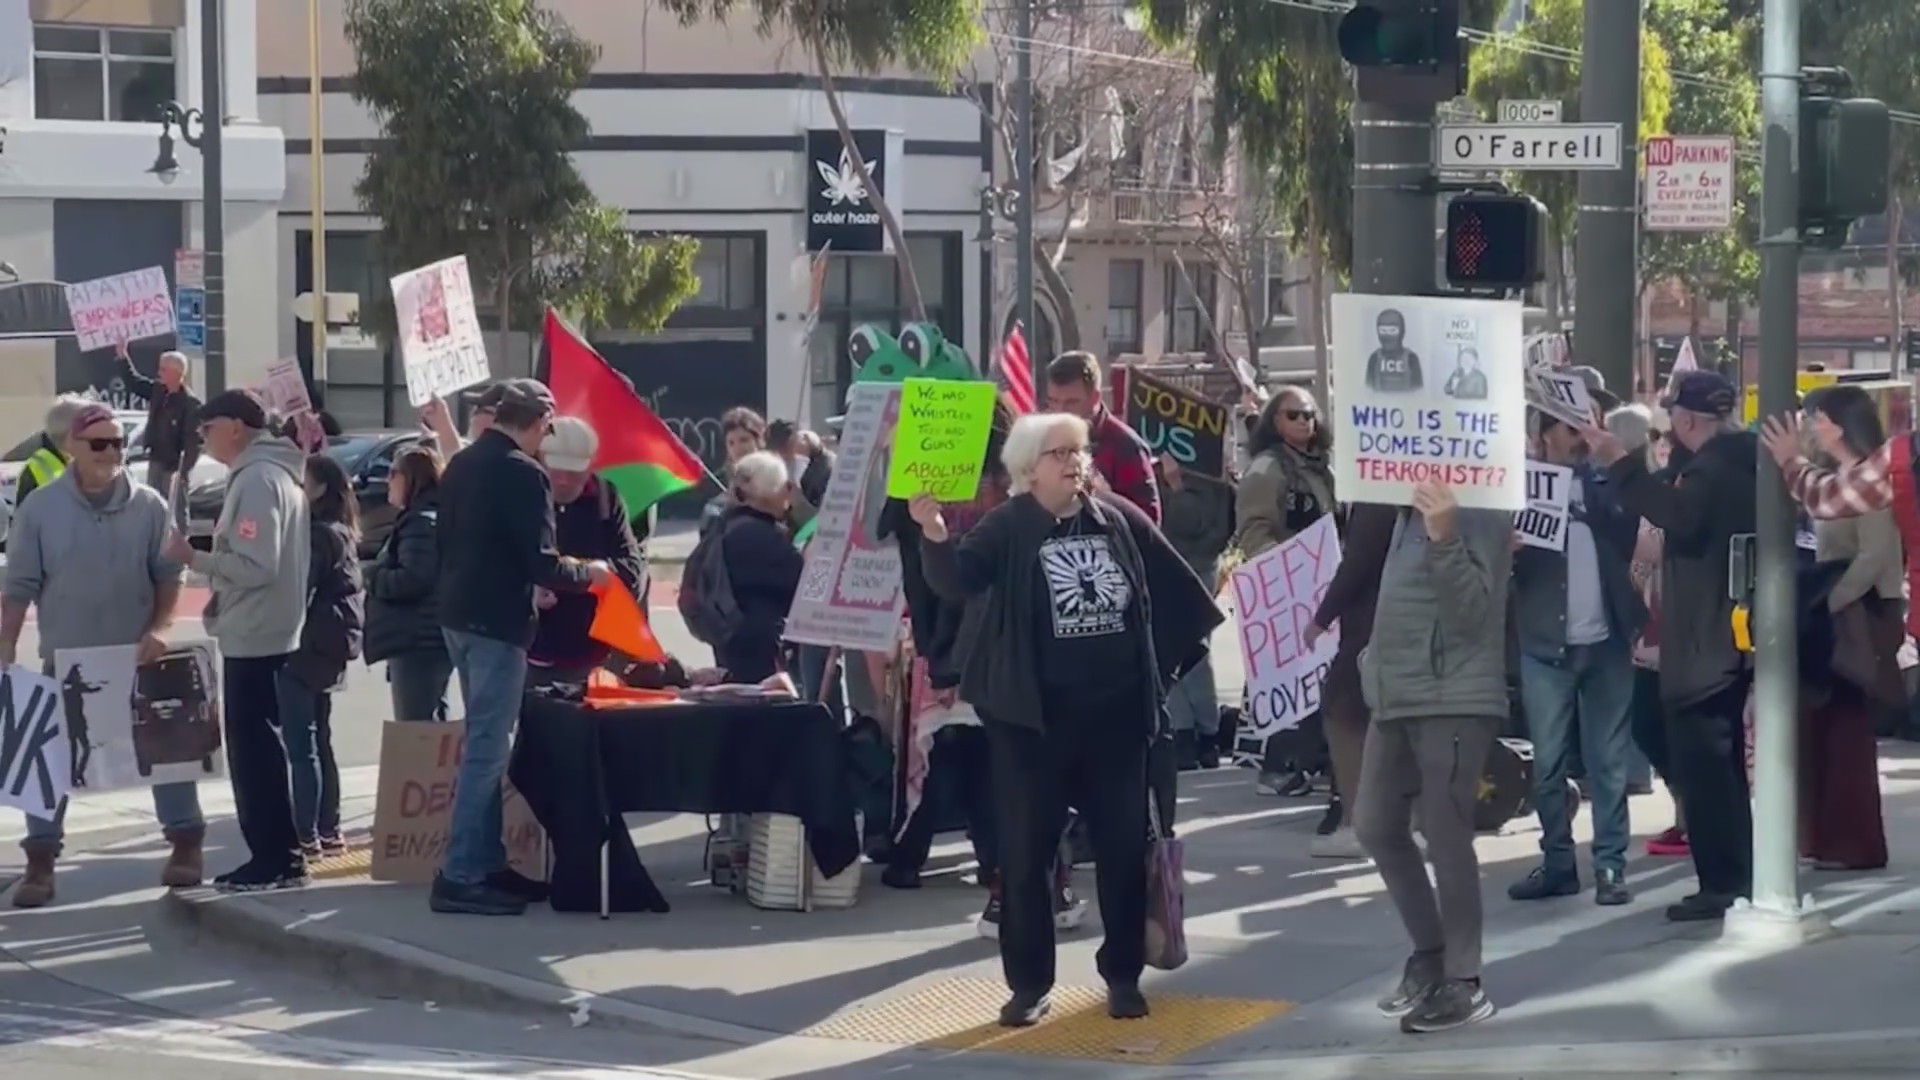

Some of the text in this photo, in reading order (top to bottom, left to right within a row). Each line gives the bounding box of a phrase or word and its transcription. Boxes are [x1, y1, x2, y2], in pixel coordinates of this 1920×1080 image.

[1503, 104, 1540, 120] 1000
[1455, 134, 1602, 158] O'Farrell
[1648, 140, 1729, 164] NO PARKING
[1657, 190, 1719, 200] EVERYDAY
[812, 210, 880, 224] outer haze
[74, 293, 166, 331] EMPOWERS
[83, 316, 165, 345] TRUMP
[1446, 330, 1475, 341] KINGS
[1451, 319, 1469, 330] NO
[1380, 360, 1404, 372] ICE
[1132, 380, 1225, 436] JOIN
[1352, 405, 1499, 434] WHO IS THE
[920, 436, 956, 452] GUNS
[1140, 415, 1198, 463] US
[1359, 431, 1488, 460] DOMESTIC
[904, 461, 976, 479] ABOLISH
[1355, 457, 1507, 487] TERRORIST??
[1526, 470, 1559, 501] UT
[1232, 525, 1327, 620] DEFY
